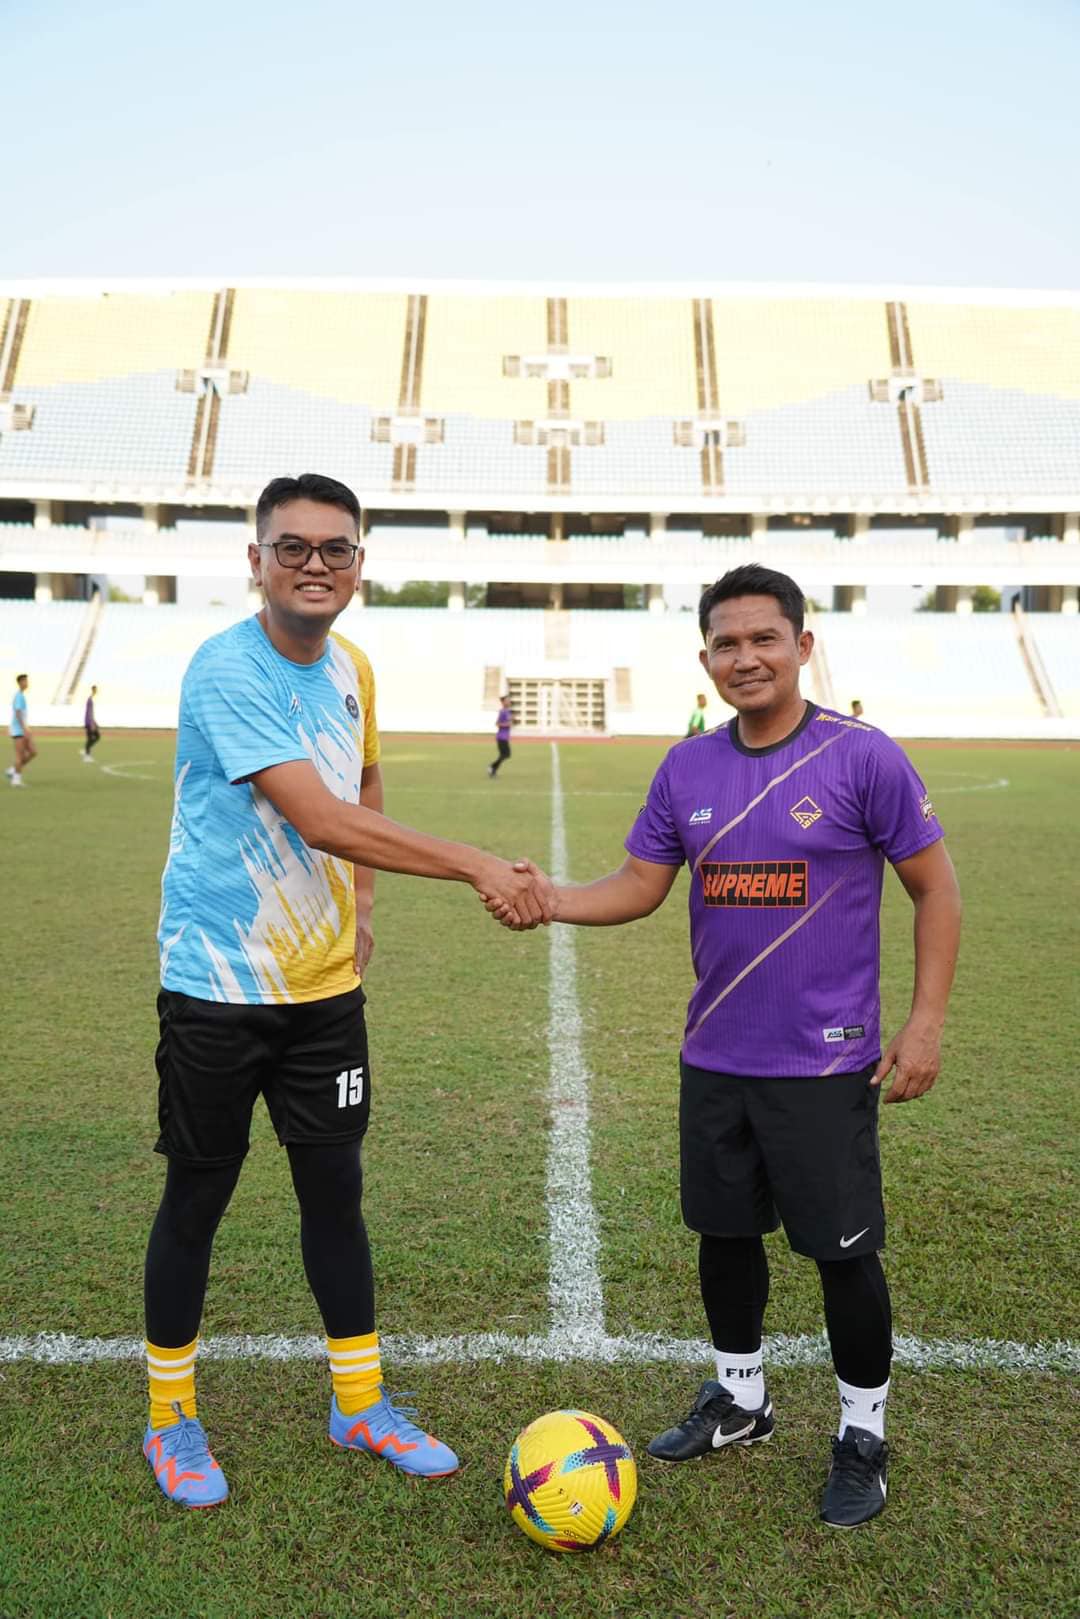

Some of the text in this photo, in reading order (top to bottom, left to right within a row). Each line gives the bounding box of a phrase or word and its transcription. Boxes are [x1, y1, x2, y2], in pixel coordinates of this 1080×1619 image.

[703, 873, 805, 898] SUPREME
[336, 1066, 363, 1109] 15
[726, 1364, 762, 1379] FIFA
